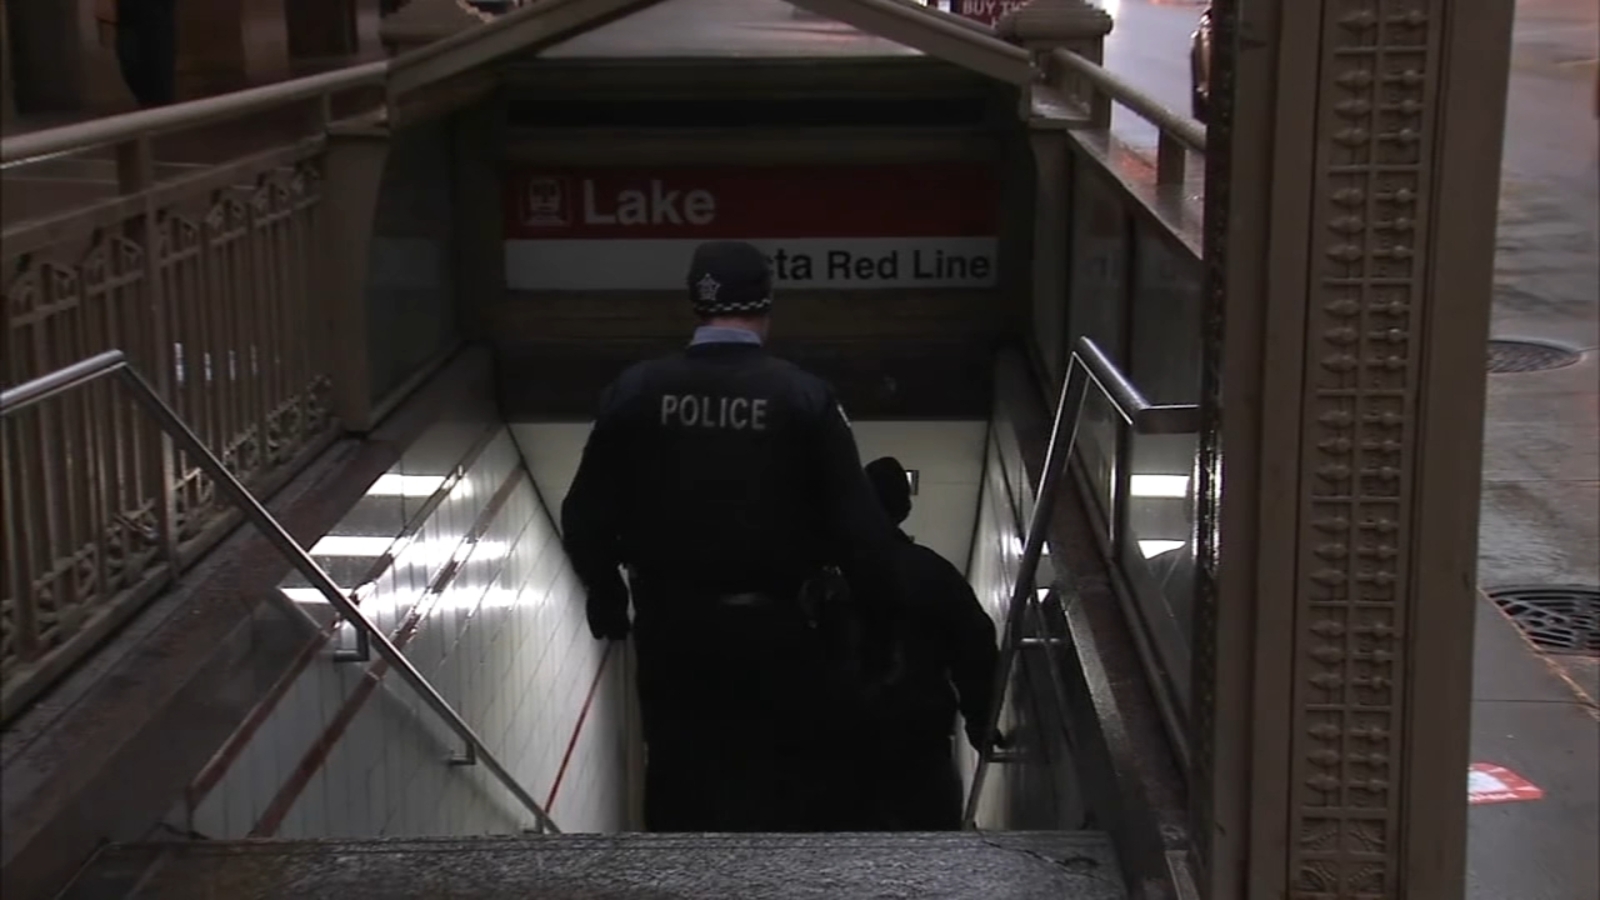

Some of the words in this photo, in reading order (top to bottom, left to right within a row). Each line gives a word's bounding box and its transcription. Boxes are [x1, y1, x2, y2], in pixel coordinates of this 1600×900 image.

[963, 0, 996, 15] BUY
[583, 179, 716, 225] Lake
[767, 248, 812, 280] ta
[827, 250, 898, 280] Red
[913, 250, 990, 280] Line
[660, 394, 768, 430] POLICE
